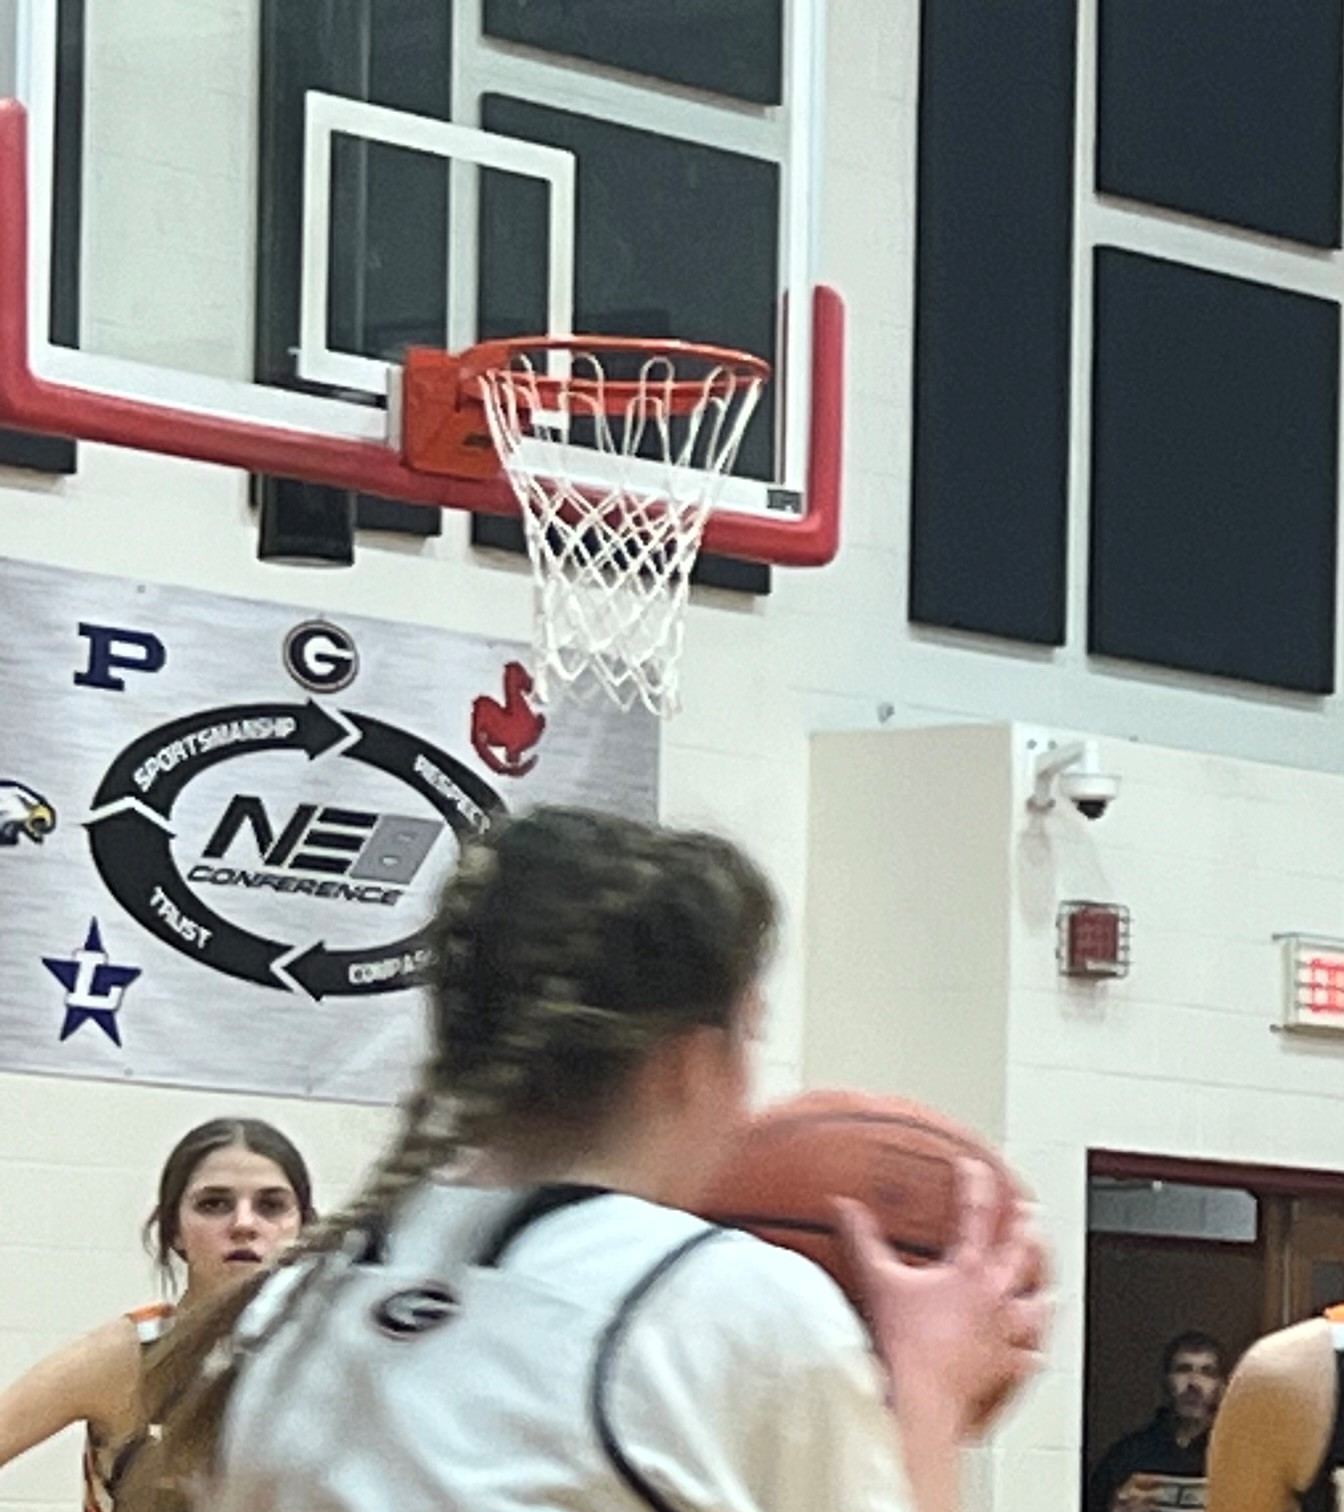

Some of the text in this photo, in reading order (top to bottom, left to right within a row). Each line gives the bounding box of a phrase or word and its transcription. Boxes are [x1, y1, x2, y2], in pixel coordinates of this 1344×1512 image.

[73, 621, 166, 692] P
[283, 620, 360, 694] G
[187, 864, 405, 906] CONFERENCE
[150, 886, 213, 949] TRUST
[67, 950, 122, 1011] L
[371, 1283, 461, 1341] G
